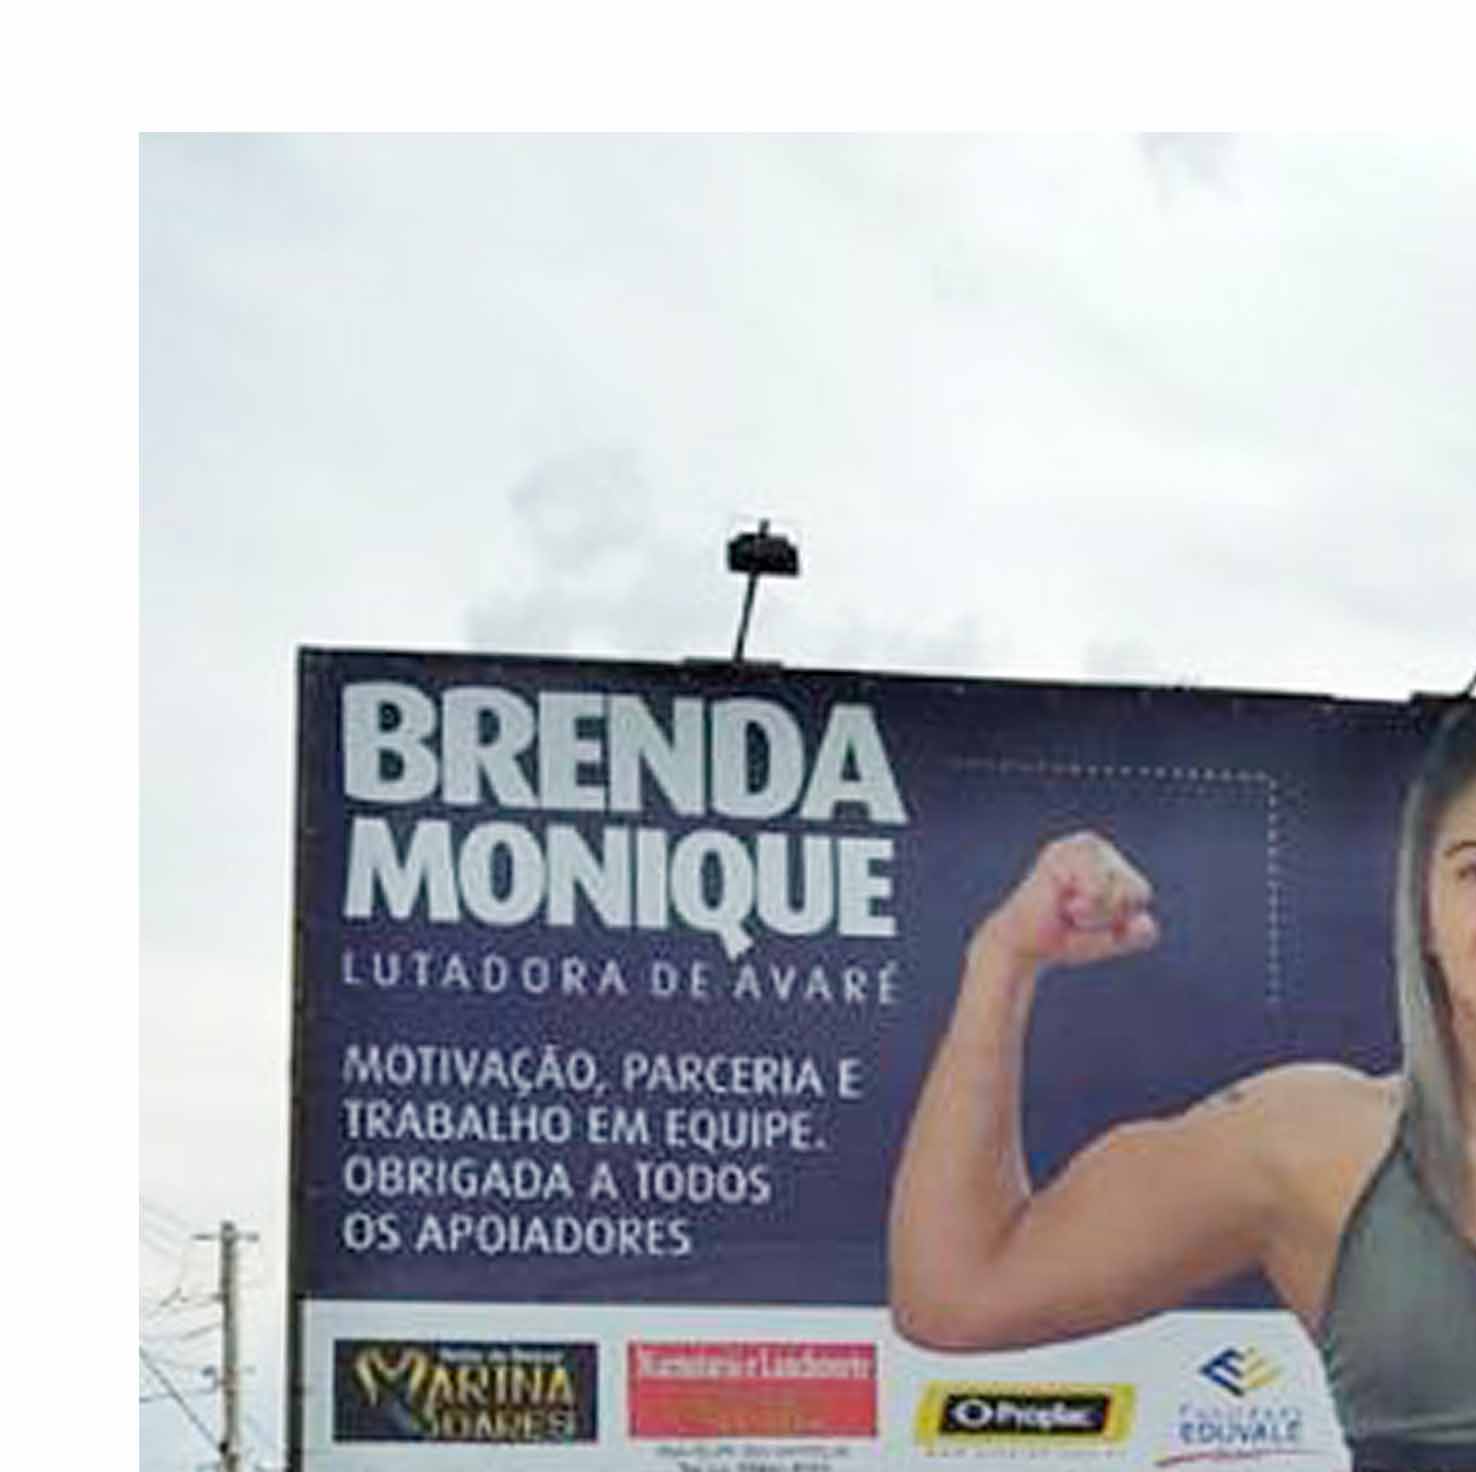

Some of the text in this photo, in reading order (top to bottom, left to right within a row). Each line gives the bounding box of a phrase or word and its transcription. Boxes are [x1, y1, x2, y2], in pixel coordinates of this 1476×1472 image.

[342, 681, 908, 824] BRENDA
[344, 817, 897, 961] MONIQUE
[343, 951, 901, 1004] LUTADORA DE AVARÉ
[343, 1044, 863, 1099] MOTIVAÇÃO, PARCERIA E
[343, 1099, 827, 1153] TRABALHO EM EQUIPE.
[343, 1156, 771, 1204] OBRIGADA A TODOS
[343, 1212, 692, 1257] OS APOIADORES
